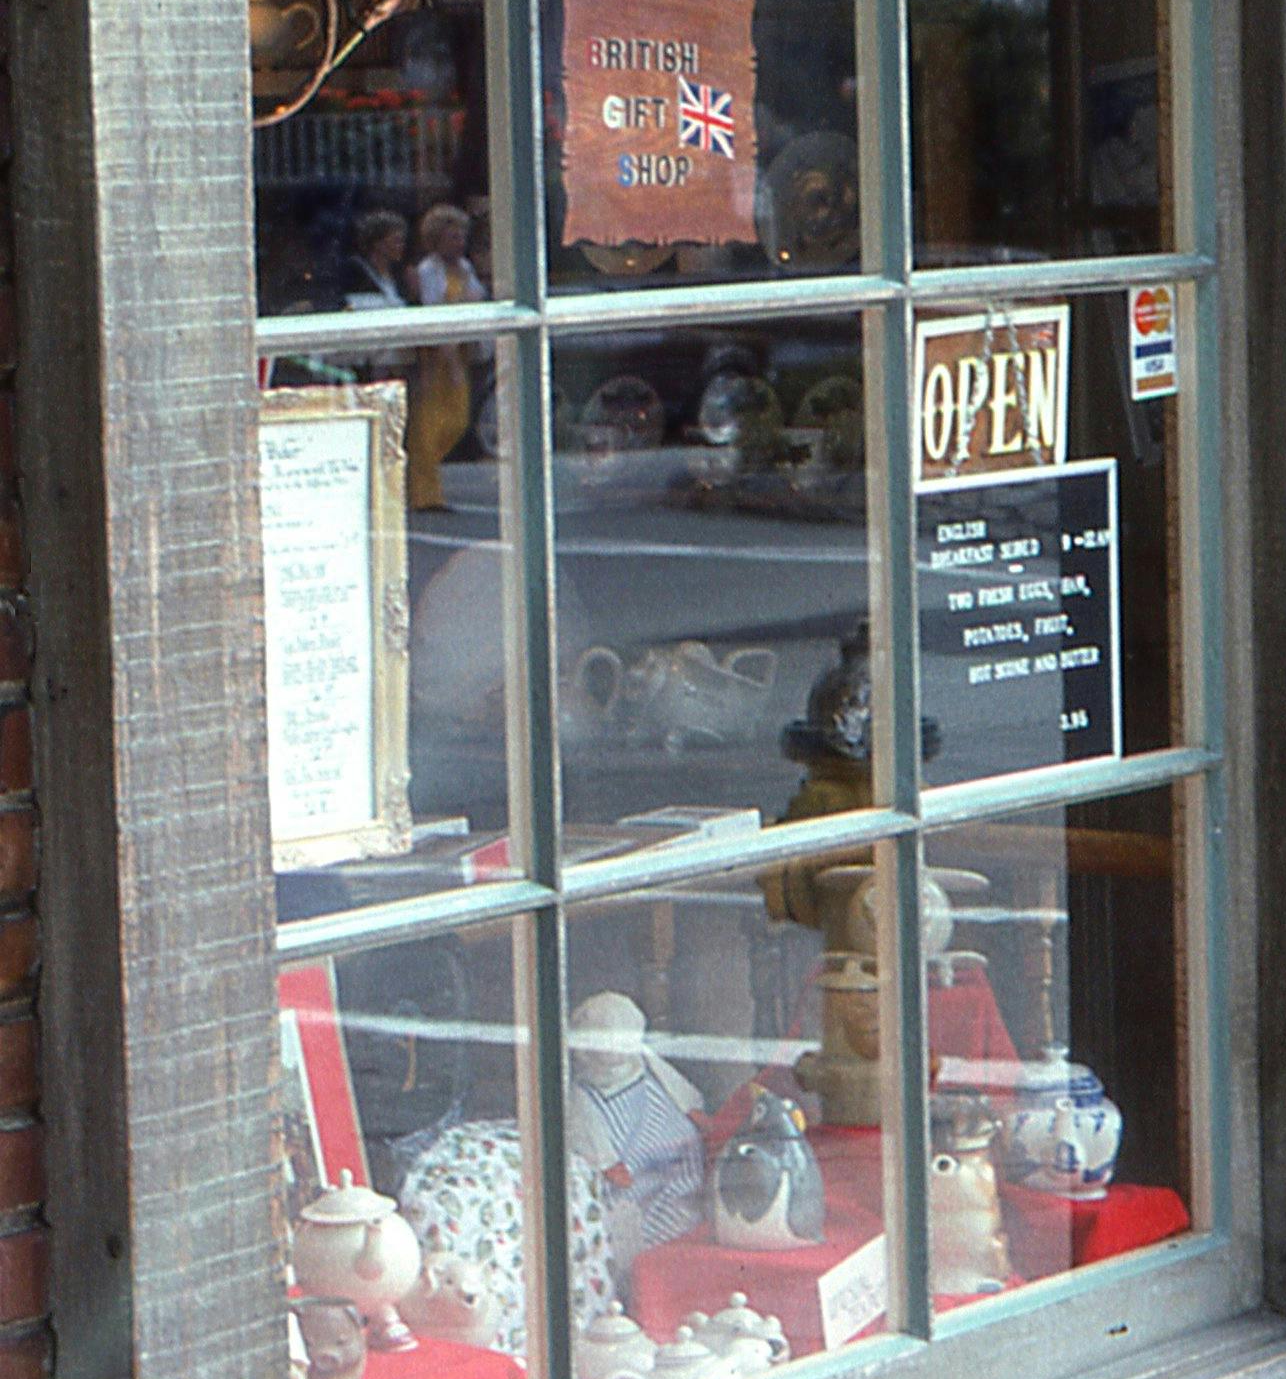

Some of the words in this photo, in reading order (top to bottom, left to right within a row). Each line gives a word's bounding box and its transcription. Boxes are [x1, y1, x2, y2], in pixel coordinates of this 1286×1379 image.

[590, 37, 698, 74] BRITISH
[603, 95, 667, 129] GIFT
[618, 154, 692, 188] SHOP
[922, 347, 1057, 461] OPEN
